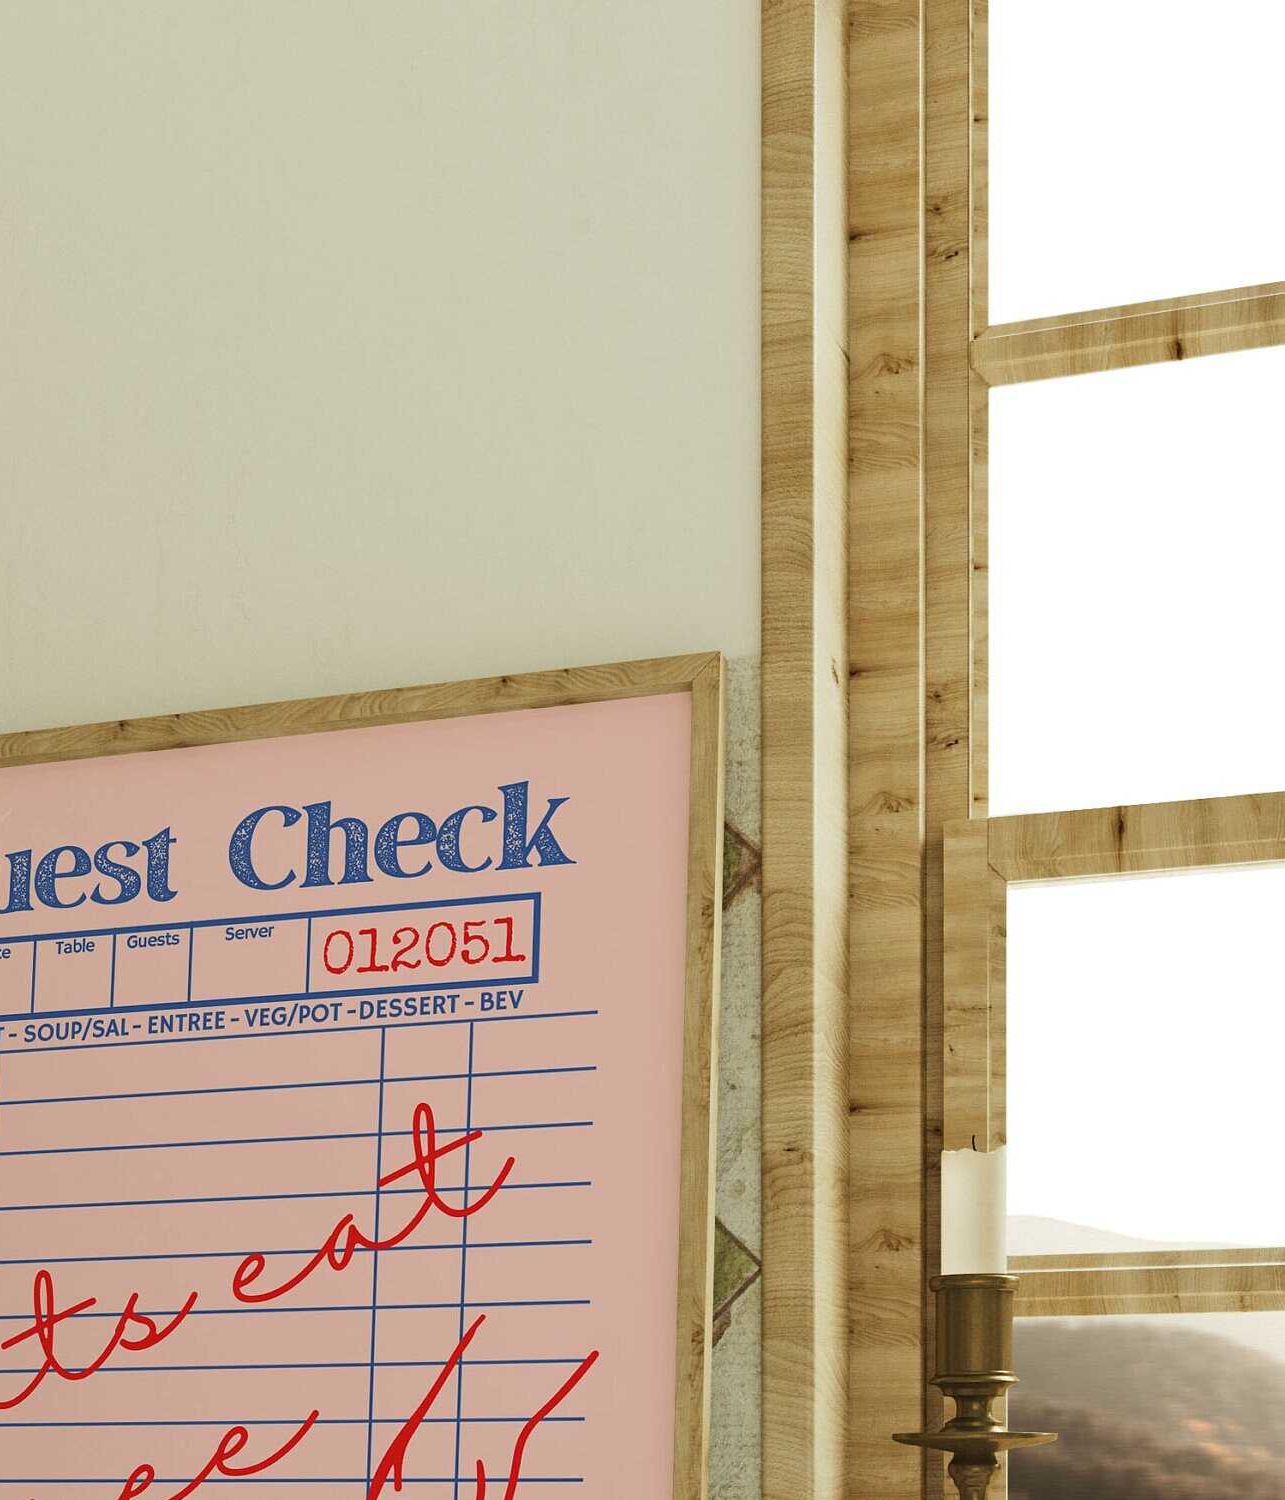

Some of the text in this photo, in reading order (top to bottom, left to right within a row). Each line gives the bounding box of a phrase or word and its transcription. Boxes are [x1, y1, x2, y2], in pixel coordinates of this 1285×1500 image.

[228, 779, 577, 891] Check
[54, 938, 96, 955] Table
[126, 932, 181, 950] Guests
[224, 924, 275, 941] Server
[323, 917, 526, 975] 012051
[23, 1017, 130, 1043] SOUP/SAL
[147, 1011, 226, 1035] ENTREE
[244, 1002, 343, 1028] VEG/POT
[479, 989, 524, 1012] BEV
[232, 1102, 515, 1304] eat
